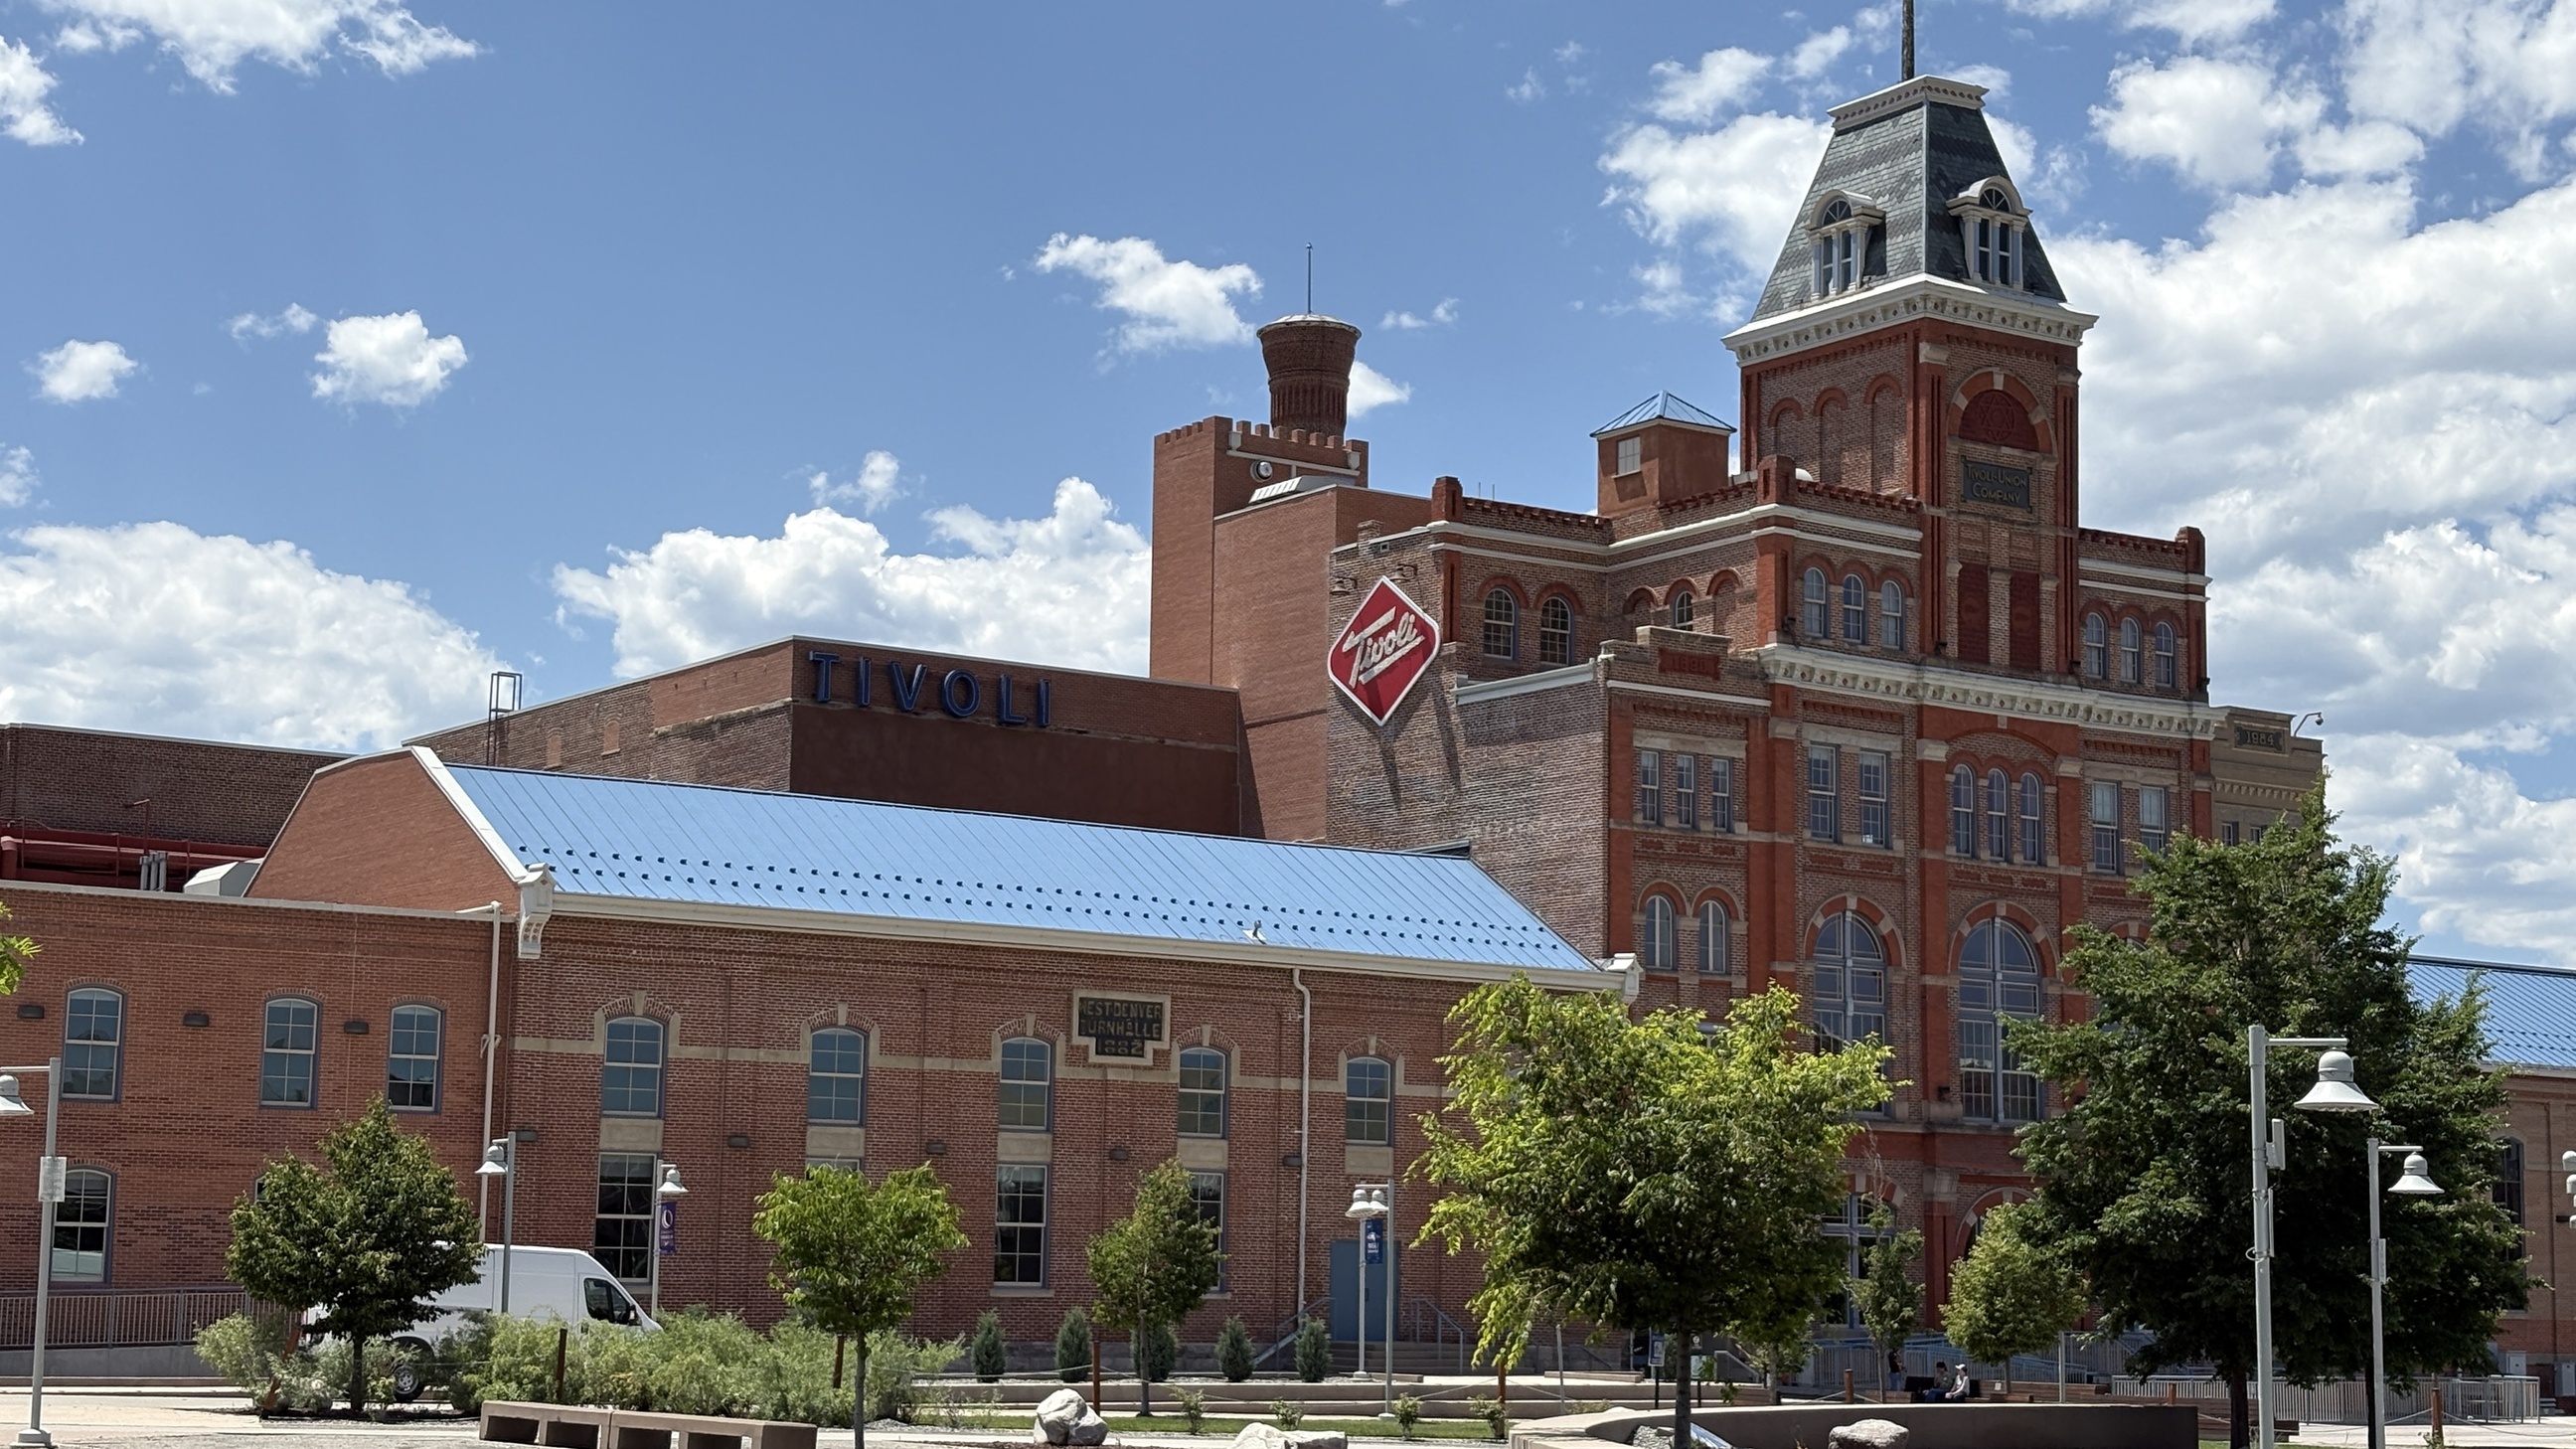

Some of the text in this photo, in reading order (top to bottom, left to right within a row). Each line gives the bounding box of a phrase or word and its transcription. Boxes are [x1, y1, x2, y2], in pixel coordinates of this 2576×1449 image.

[1973, 482, 2020, 504] COMPANY
[1342, 605, 1419, 689] Tivoli
[809, 651, 1051, 726] TIVOLI
[2246, 730, 2275, 746] 1984
[1113, 1002, 1161, 1020] DENVER
